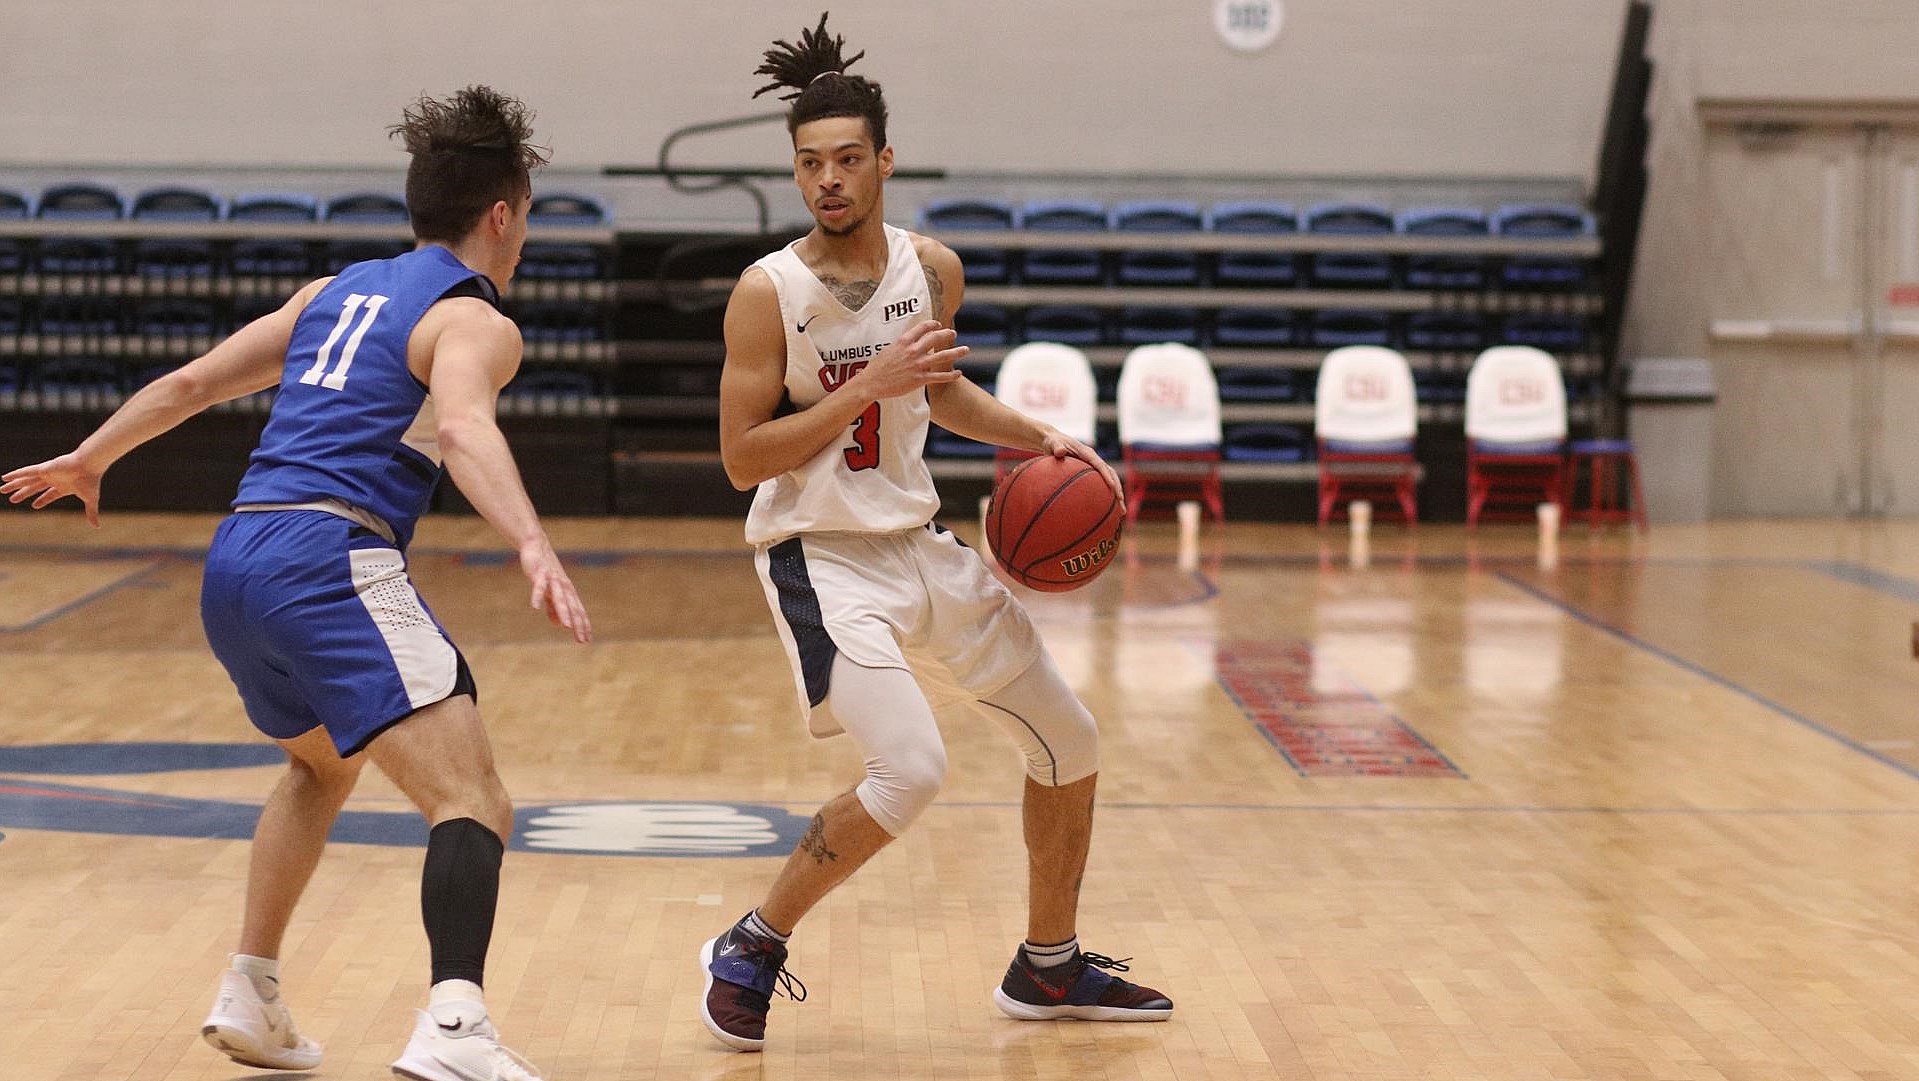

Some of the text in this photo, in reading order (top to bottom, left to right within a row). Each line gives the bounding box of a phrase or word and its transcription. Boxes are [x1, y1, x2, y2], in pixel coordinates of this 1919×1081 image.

[883, 297, 919, 322] PBC
[299, 293, 390, 391] 11
[820, 345, 872, 361] LUMBUS
[843, 400, 881, 472] 3
[1061, 539, 1115, 576] Wil
